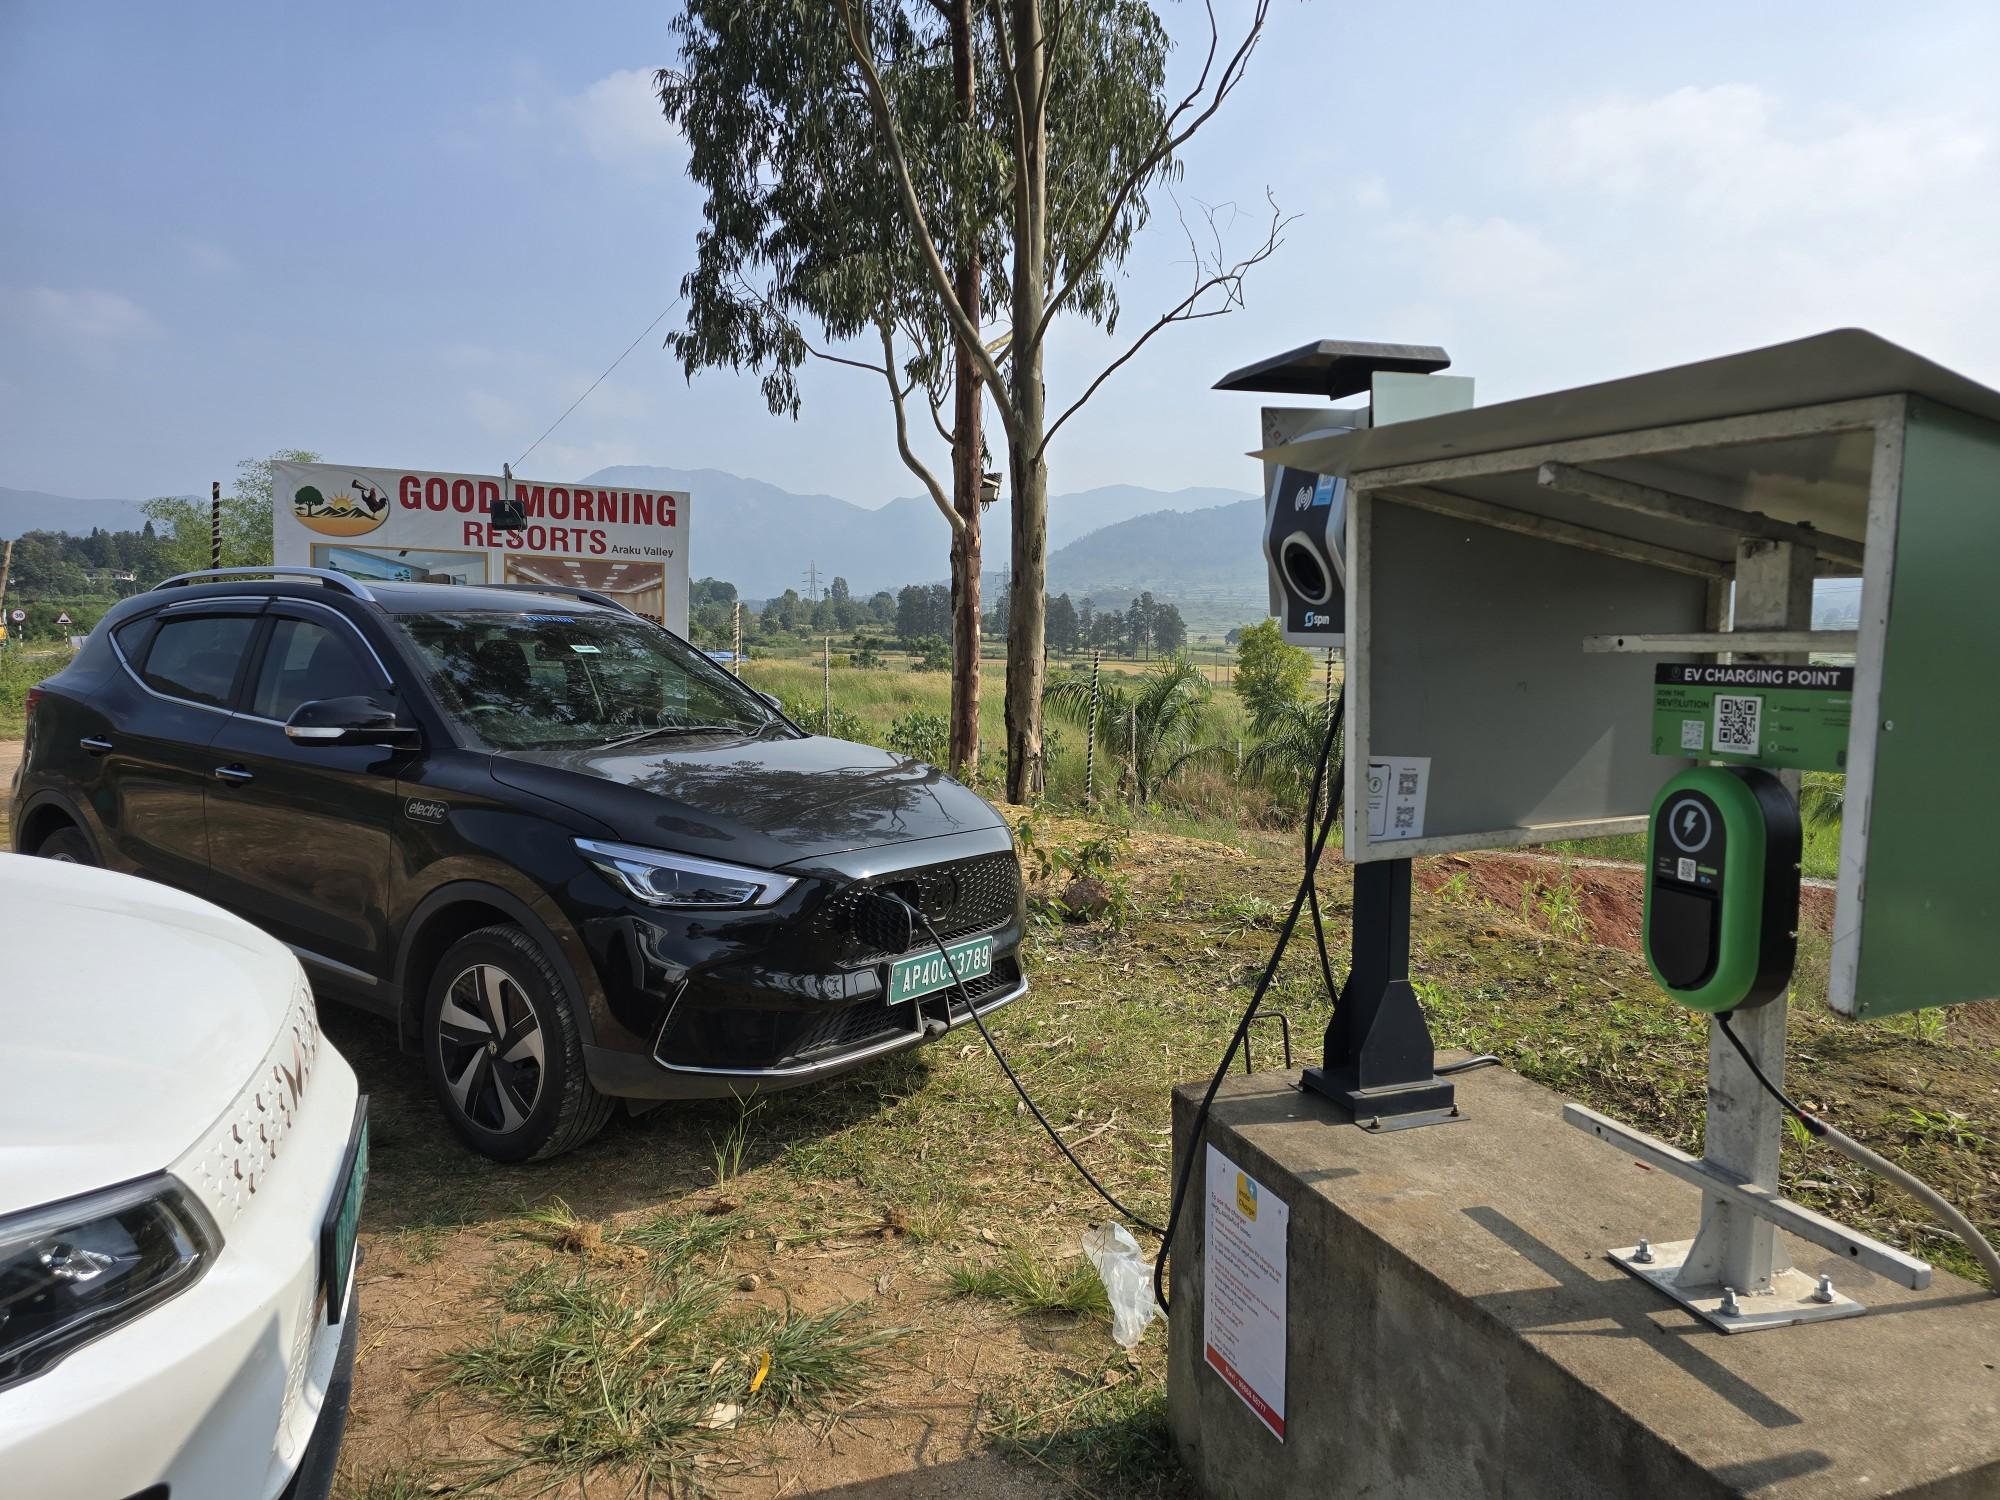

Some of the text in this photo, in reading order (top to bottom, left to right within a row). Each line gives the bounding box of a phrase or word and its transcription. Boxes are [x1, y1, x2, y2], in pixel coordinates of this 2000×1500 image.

[399, 475, 677, 527] GOOD MORNING
[463, 521, 607, 555] RESORTS
[611, 545, 674, 558] Araku Valley
[1684, 668, 1841, 686] EV CHARGING POINT
[408, 801, 445, 819] electric
